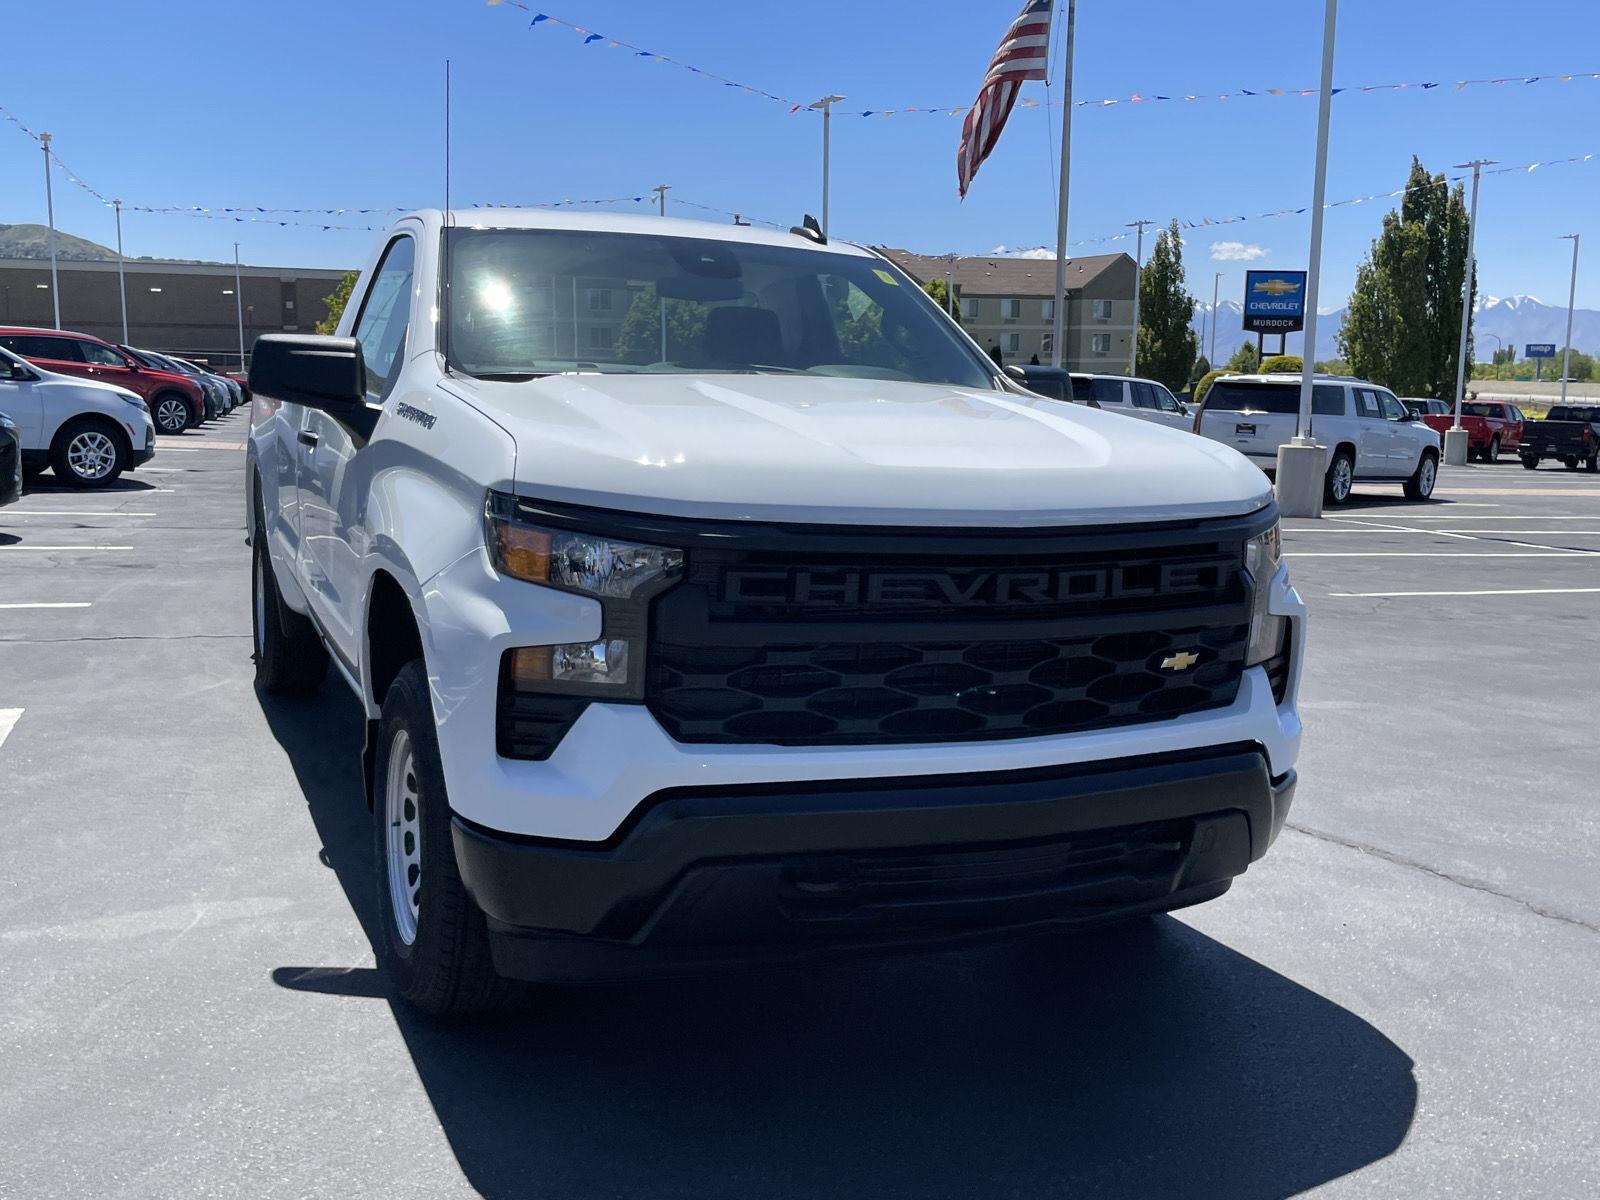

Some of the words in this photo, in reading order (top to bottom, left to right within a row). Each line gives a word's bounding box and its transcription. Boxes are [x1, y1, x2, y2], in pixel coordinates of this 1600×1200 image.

[1250, 302, 1299, 310] CHEVROLET
[1253, 319, 1294, 327] MURDOCK
[724, 559, 1238, 607] CHEVROLET
